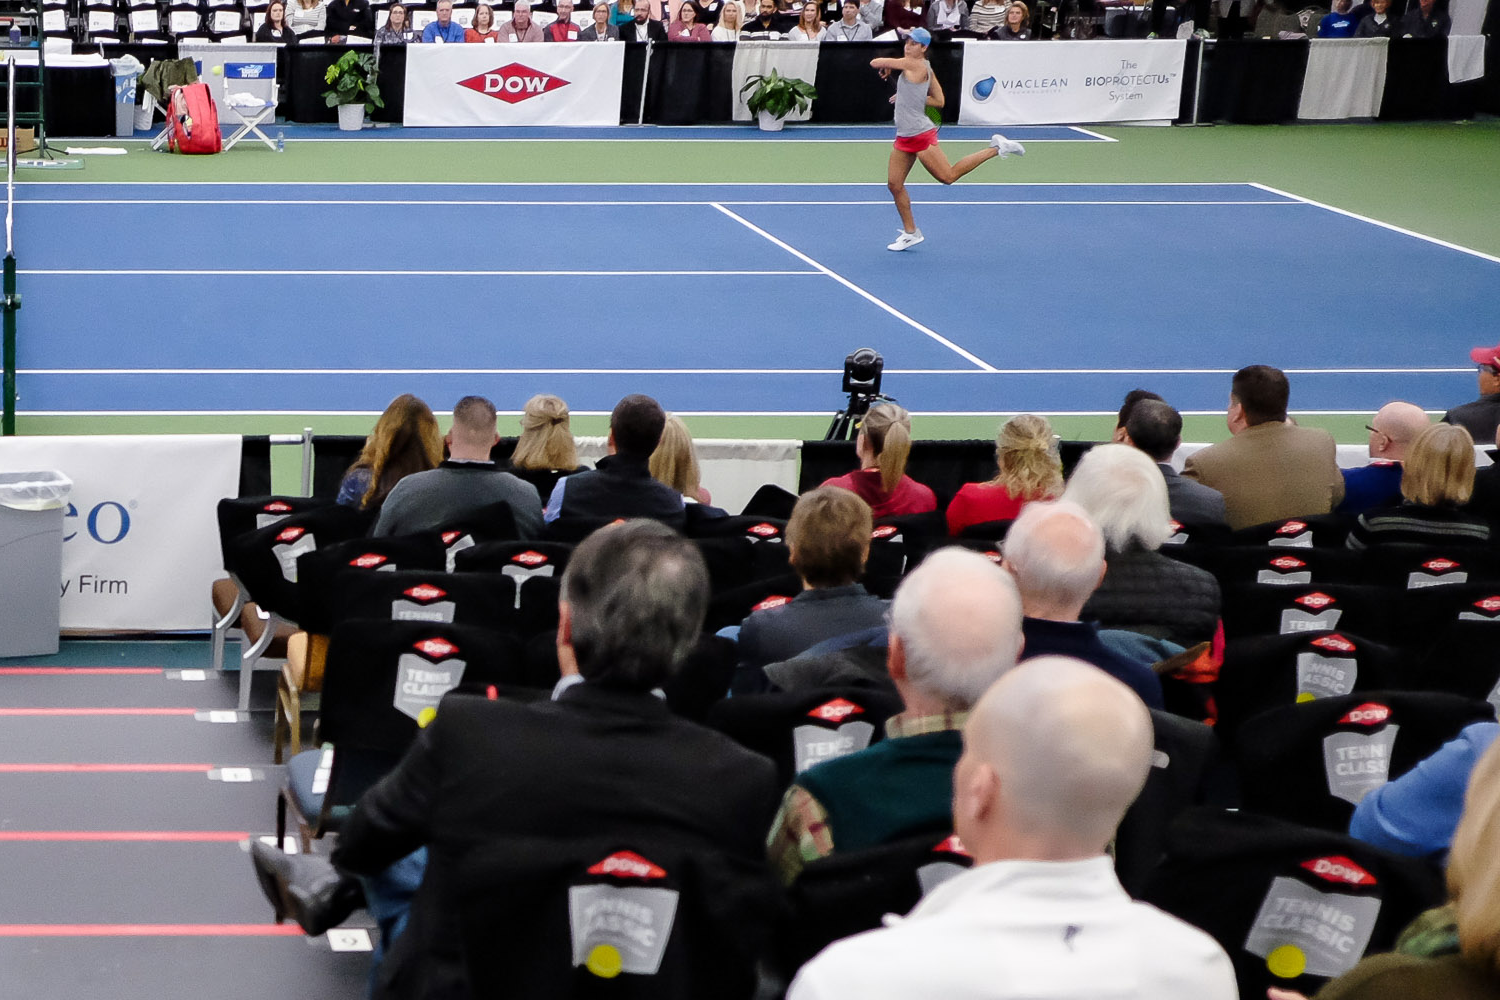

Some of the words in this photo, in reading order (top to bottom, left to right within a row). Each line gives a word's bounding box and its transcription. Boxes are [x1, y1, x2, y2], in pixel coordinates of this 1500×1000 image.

[1120, 60, 1138, 70] The
[484, 73, 550, 93] DOW
[1001, 78, 1069, 89] VIACLEAN
[1108, 91, 1143, 101] System
[80, 575, 128, 594] Firm
[1314, 859, 1365, 884] DOW
